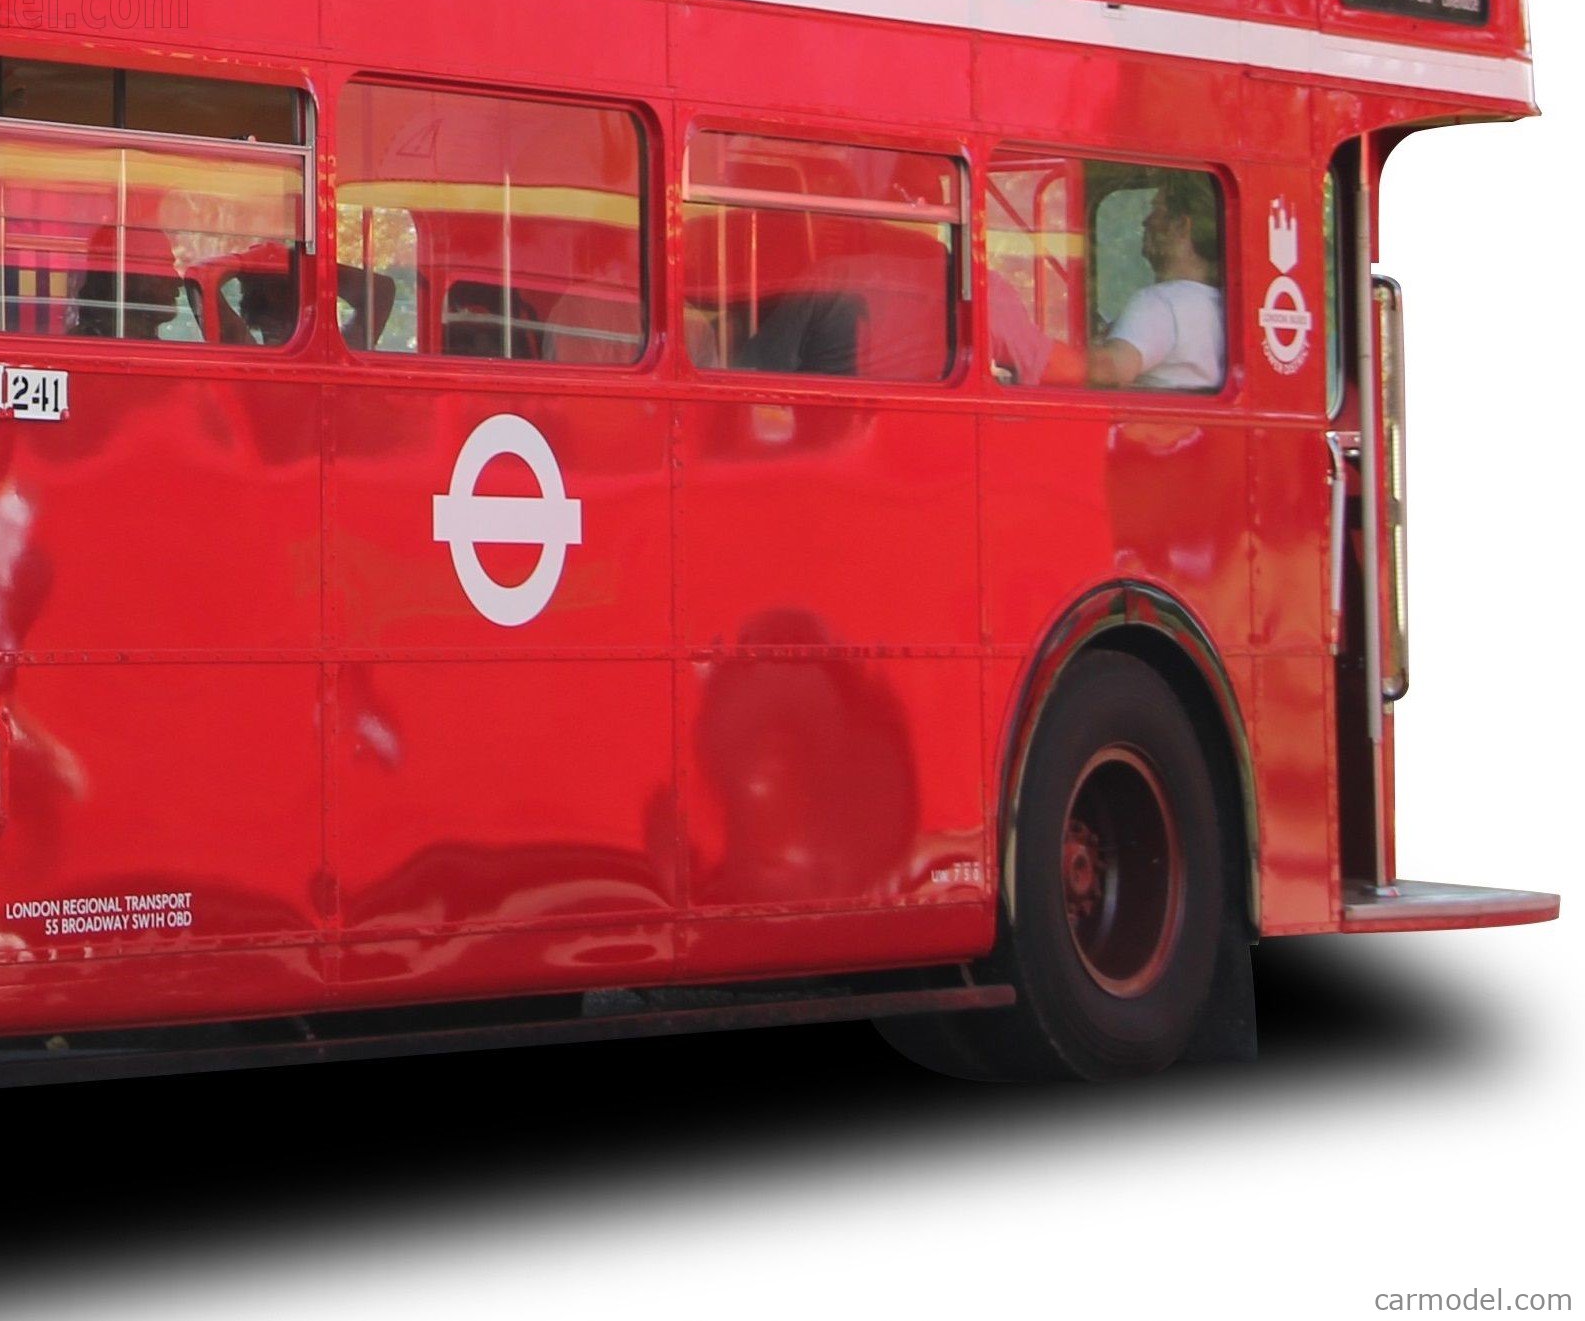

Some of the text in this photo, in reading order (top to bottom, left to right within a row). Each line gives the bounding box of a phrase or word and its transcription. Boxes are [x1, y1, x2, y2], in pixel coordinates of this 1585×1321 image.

[13, 375, 60, 412] 241
[6, 893, 192, 919] LONDON REGIONAL TRANSPORT
[45, 918, 59, 935] 55
[61, 914, 130, 934] BROADWAY
